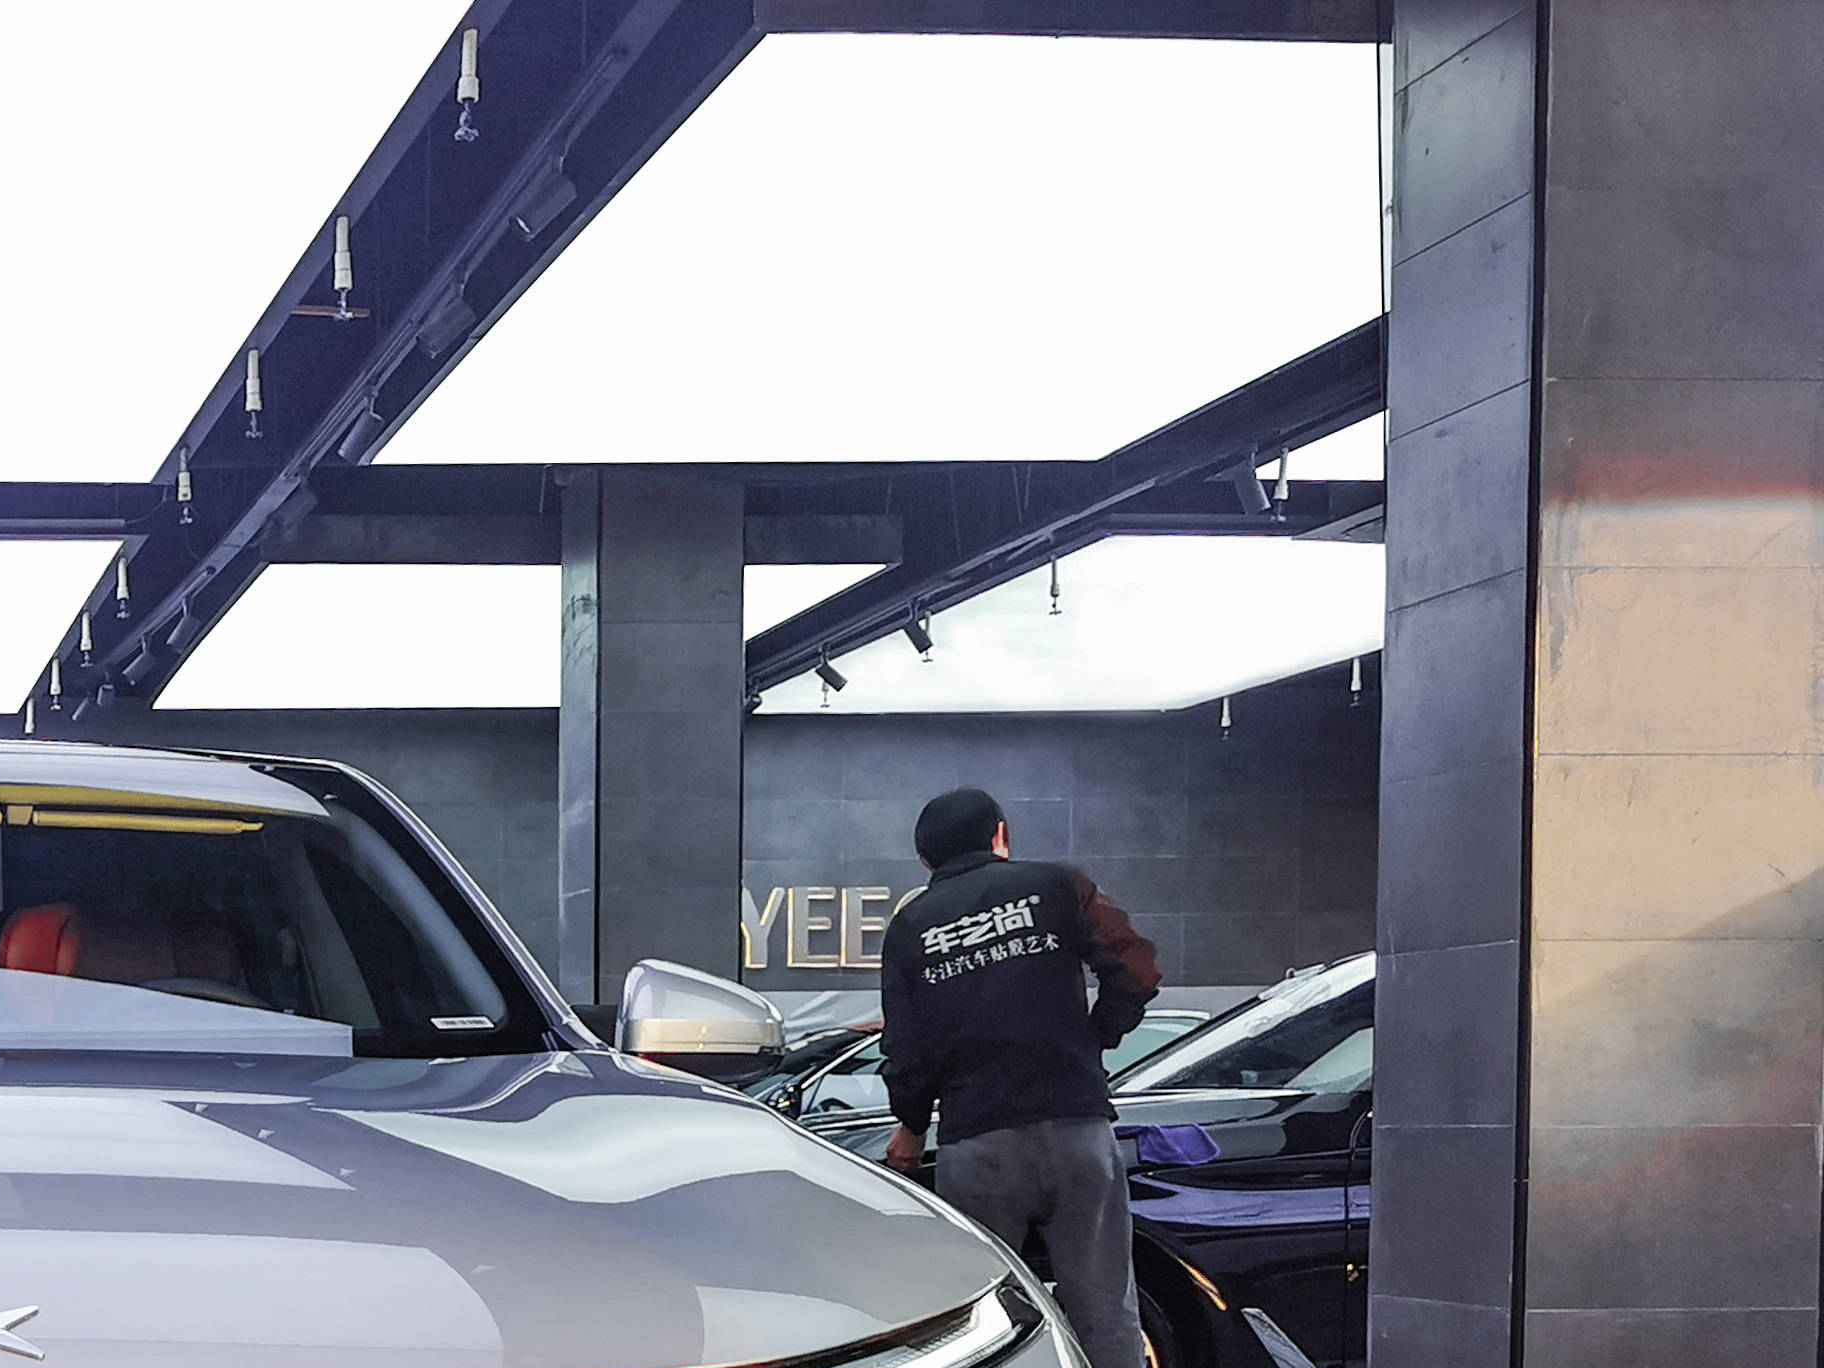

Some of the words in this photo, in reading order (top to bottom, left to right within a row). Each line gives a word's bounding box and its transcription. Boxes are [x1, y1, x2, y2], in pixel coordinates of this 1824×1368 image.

[740, 885, 929, 969] YEE
[920, 898, 1035, 955] 车艺尚
